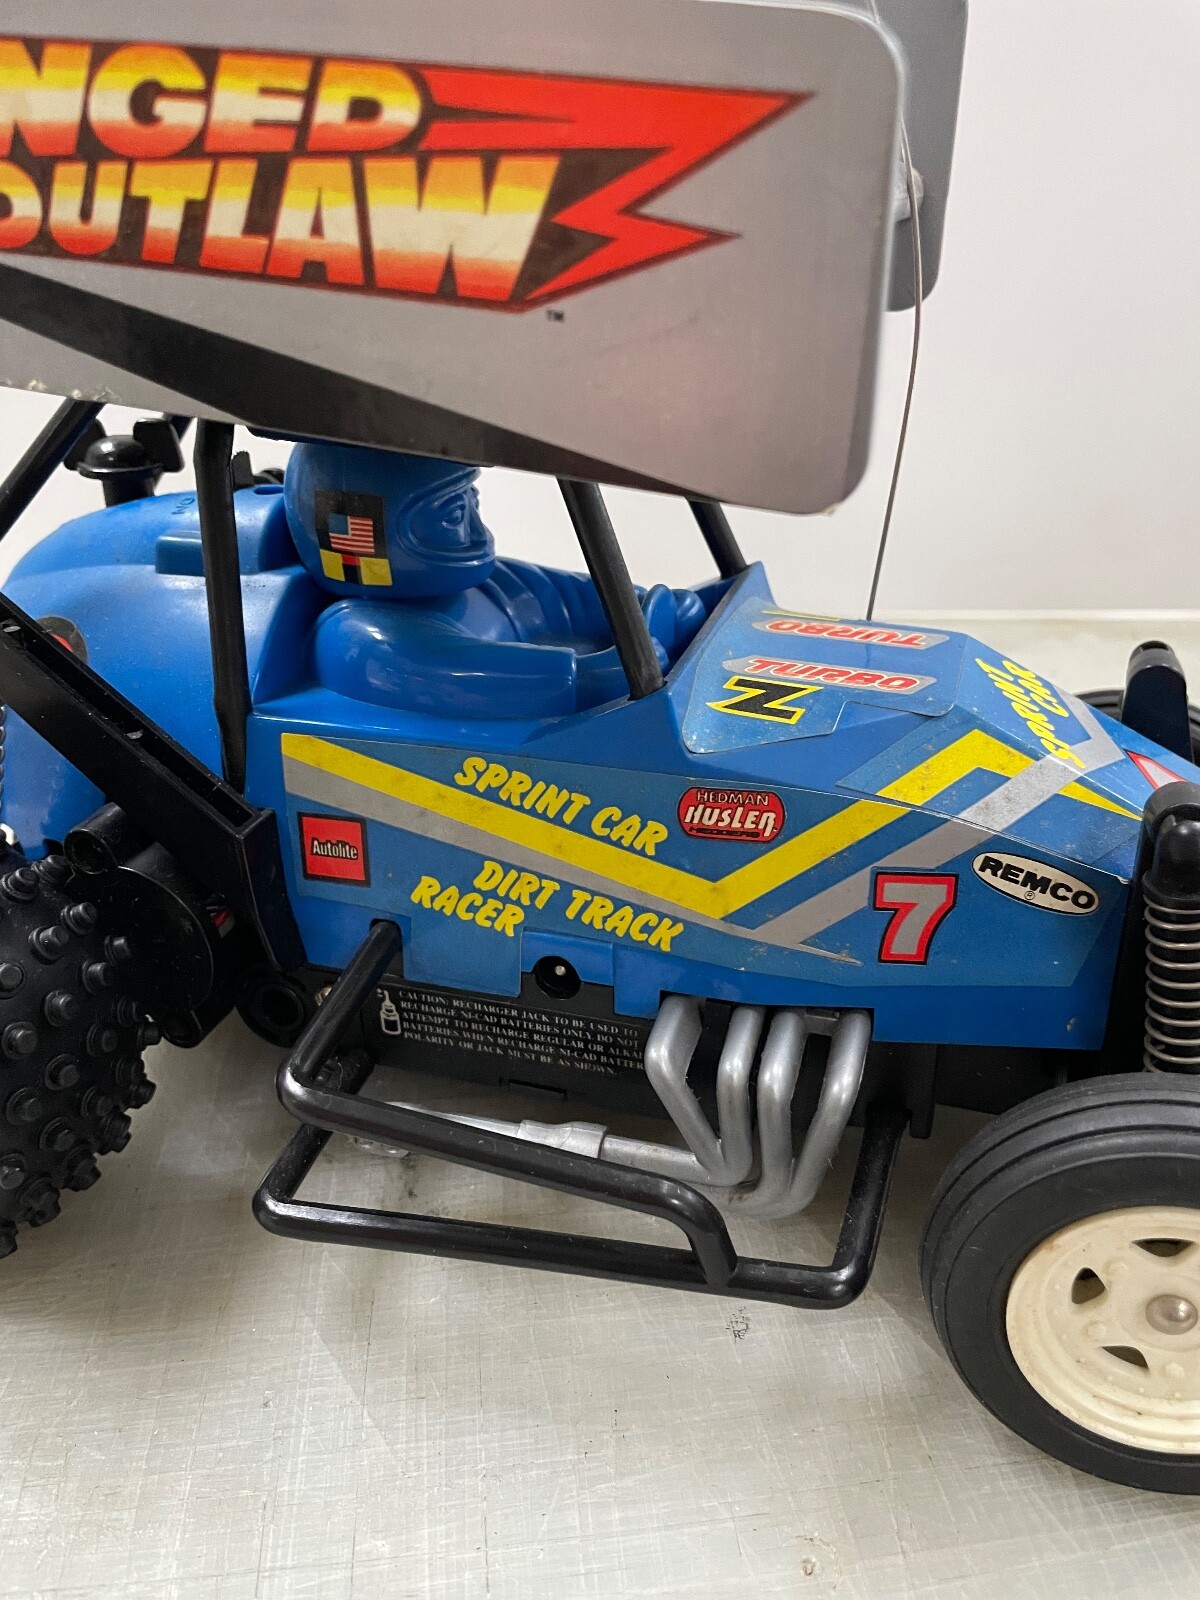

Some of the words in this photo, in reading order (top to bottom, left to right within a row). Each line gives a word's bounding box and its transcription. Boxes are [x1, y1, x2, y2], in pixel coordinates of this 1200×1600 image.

[766, 619, 926, 649] TURBO
[747, 658, 920, 691] TURBO
[454, 756, 591, 825] SPRINT
[590, 805, 668, 856] CAR
[697, 791, 769, 806] HEDMAN
[312, 838, 359, 860] Autolite
[978, 855, 1096, 910] REMCO
[410, 875, 525, 938] RACER
[472, 859, 560, 910] DIRT
[566, 889, 684, 952] TRACK
[873, 872, 959, 966] 7
[400, 999, 456, 1017] RECHARGE
[500, 1016, 559, 1034] BATTERIES
[597, 1033, 612, 1043] DO
[617, 1036, 638, 1048] NOT
[402, 1010, 448, 1025] ATTEMPT
[454, 1019, 468, 1028] TO
[471, 1022, 529, 1039] RECHARGE
[533, 1032, 584, 1048] REGULAR
[588, 1042, 603, 1052] OR
[402, 1020, 459, 1037] BATTERIES
[462, 1031, 493, 1043] WHEN
[497, 1037, 555, 1054] RECHARGE
[453, 998, 517, 1017] RECHARGER
[522, 1010, 549, 1022] JACK
[555, 1016, 568, 1026] TO
[572, 1019, 585, 1028] BE
[590, 1022, 617, 1034] USED
[624, 1028, 637, 1037] TO
[404, 1030, 453, 1046] POLARITY
[540, 1053, 552, 1063] BE
